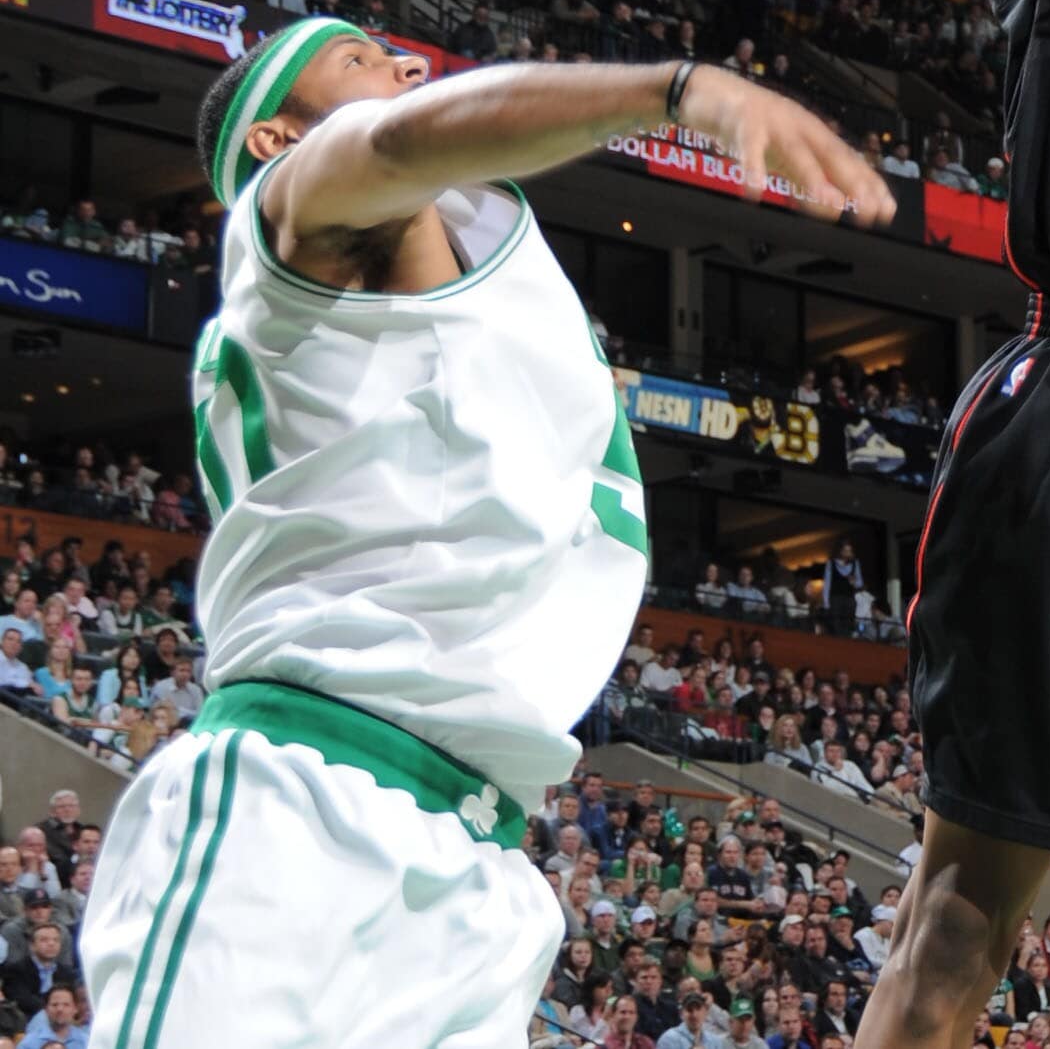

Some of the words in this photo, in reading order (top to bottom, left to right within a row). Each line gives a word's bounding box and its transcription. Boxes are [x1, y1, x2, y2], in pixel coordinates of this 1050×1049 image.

[607, 133, 698, 172] DOLLAR
[635, 389, 692, 427] NESN
[699, 398, 739, 440] HD
